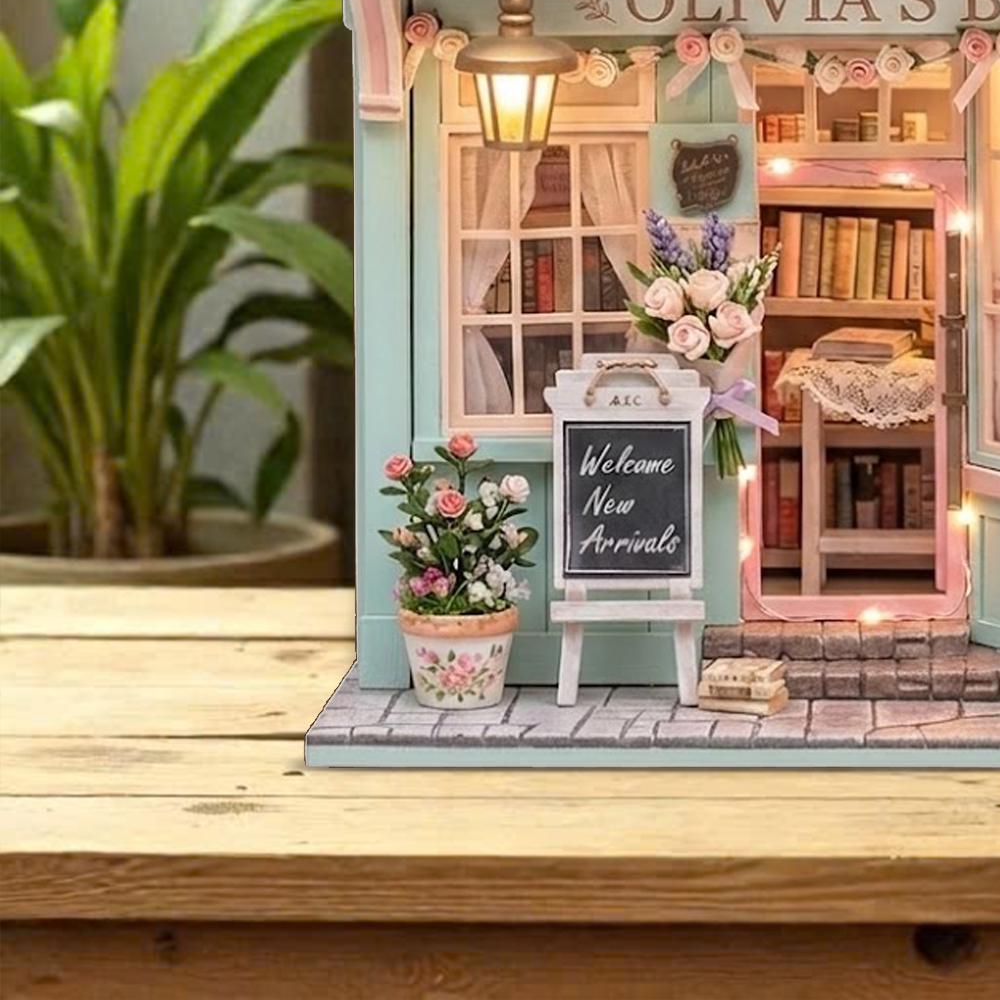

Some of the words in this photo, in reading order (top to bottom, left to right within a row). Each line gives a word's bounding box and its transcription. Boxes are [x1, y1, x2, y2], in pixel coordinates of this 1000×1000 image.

[579, 442, 676, 477] Welcome
[582, 483, 635, 516] New
[579, 523, 681, 555] Arrivals
